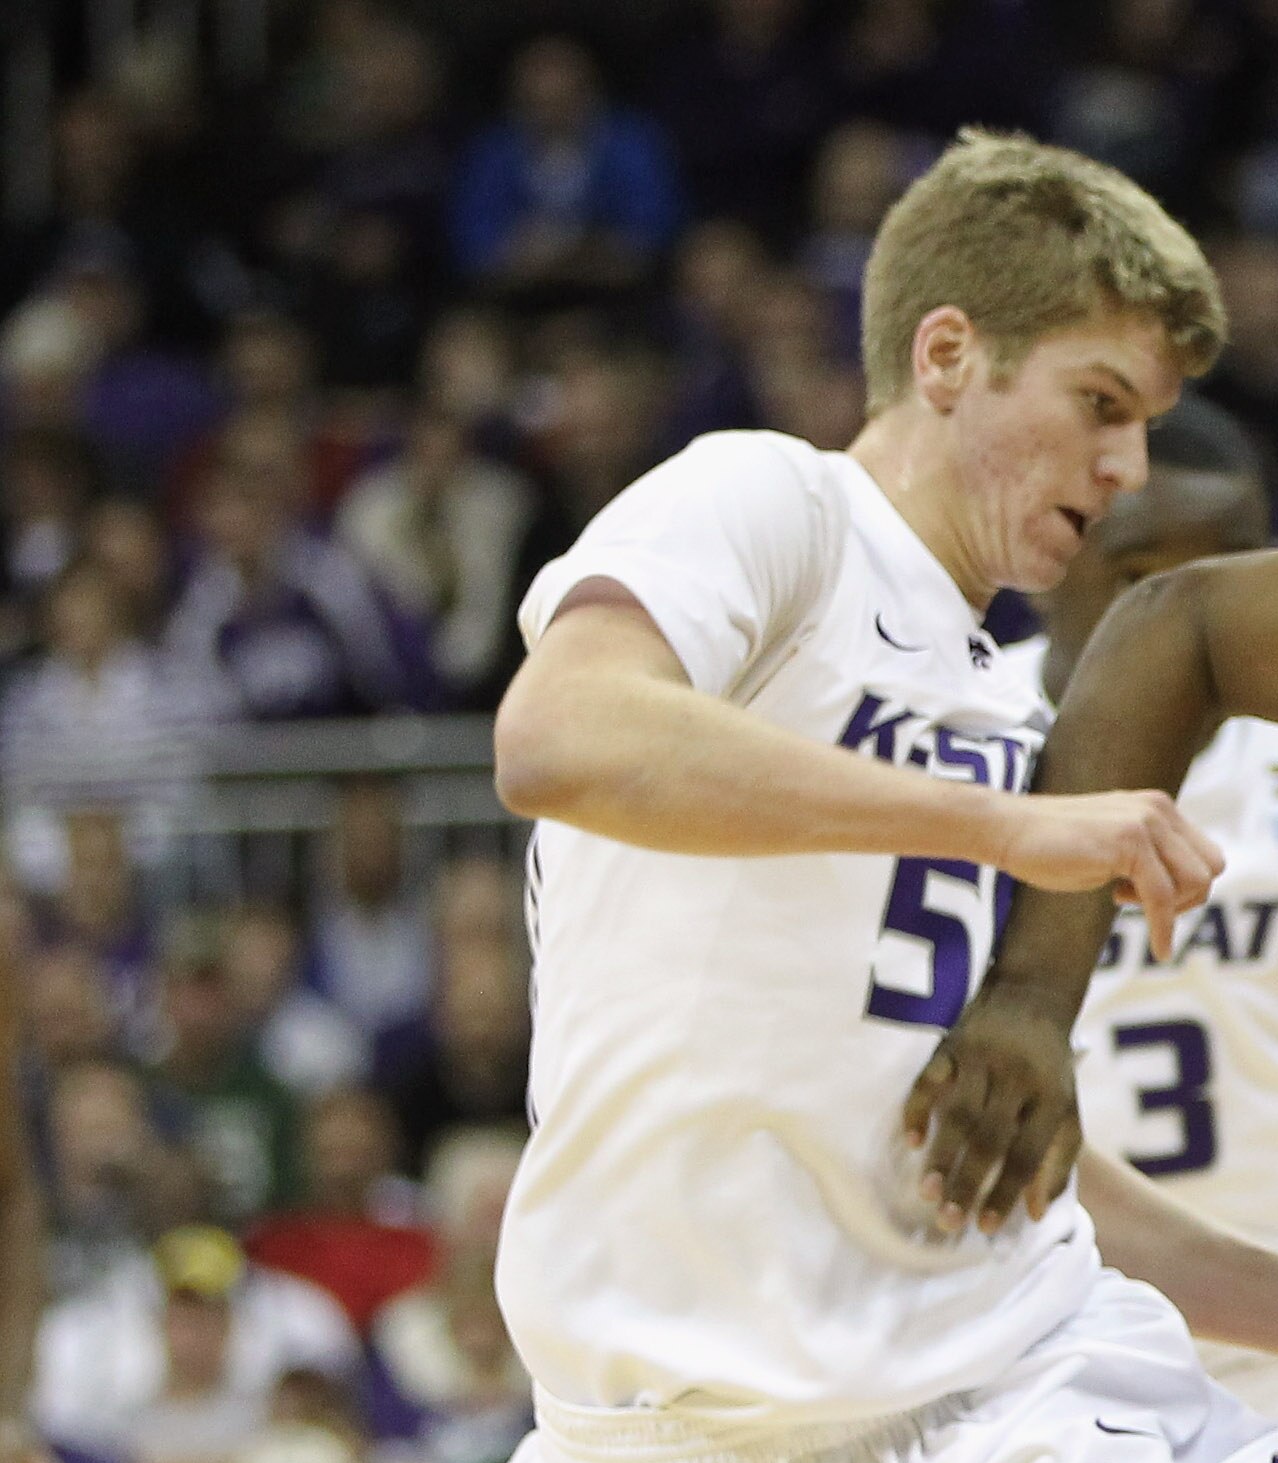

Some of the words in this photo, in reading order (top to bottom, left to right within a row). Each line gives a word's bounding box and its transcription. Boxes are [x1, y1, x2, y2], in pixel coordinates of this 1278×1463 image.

[836, 690, 1030, 793] K-ST
[864, 855, 1014, 1030] 5
[1112, 1018, 1218, 1177] 3
